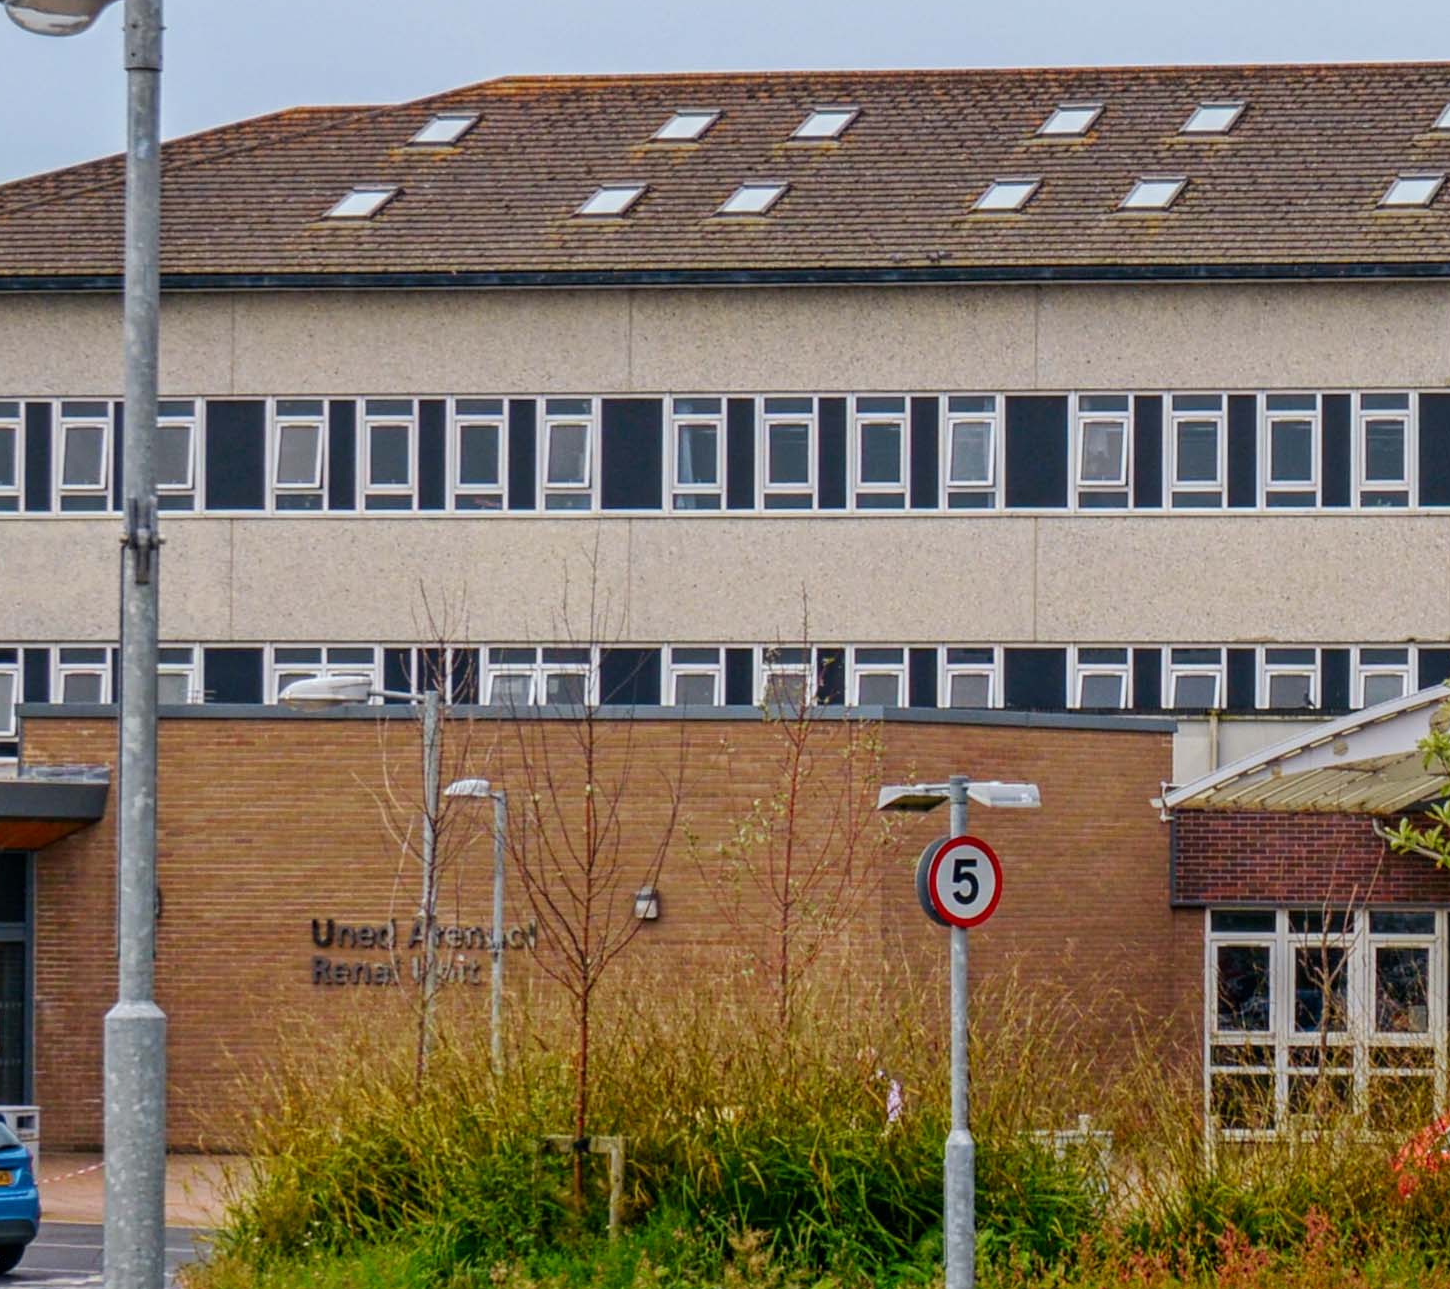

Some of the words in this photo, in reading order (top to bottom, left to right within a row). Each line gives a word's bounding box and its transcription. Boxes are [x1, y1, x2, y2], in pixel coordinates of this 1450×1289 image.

[952, 858, 979, 906] 5
[311, 918, 398, 949] Uned
[312, 955, 401, 986] Renal
